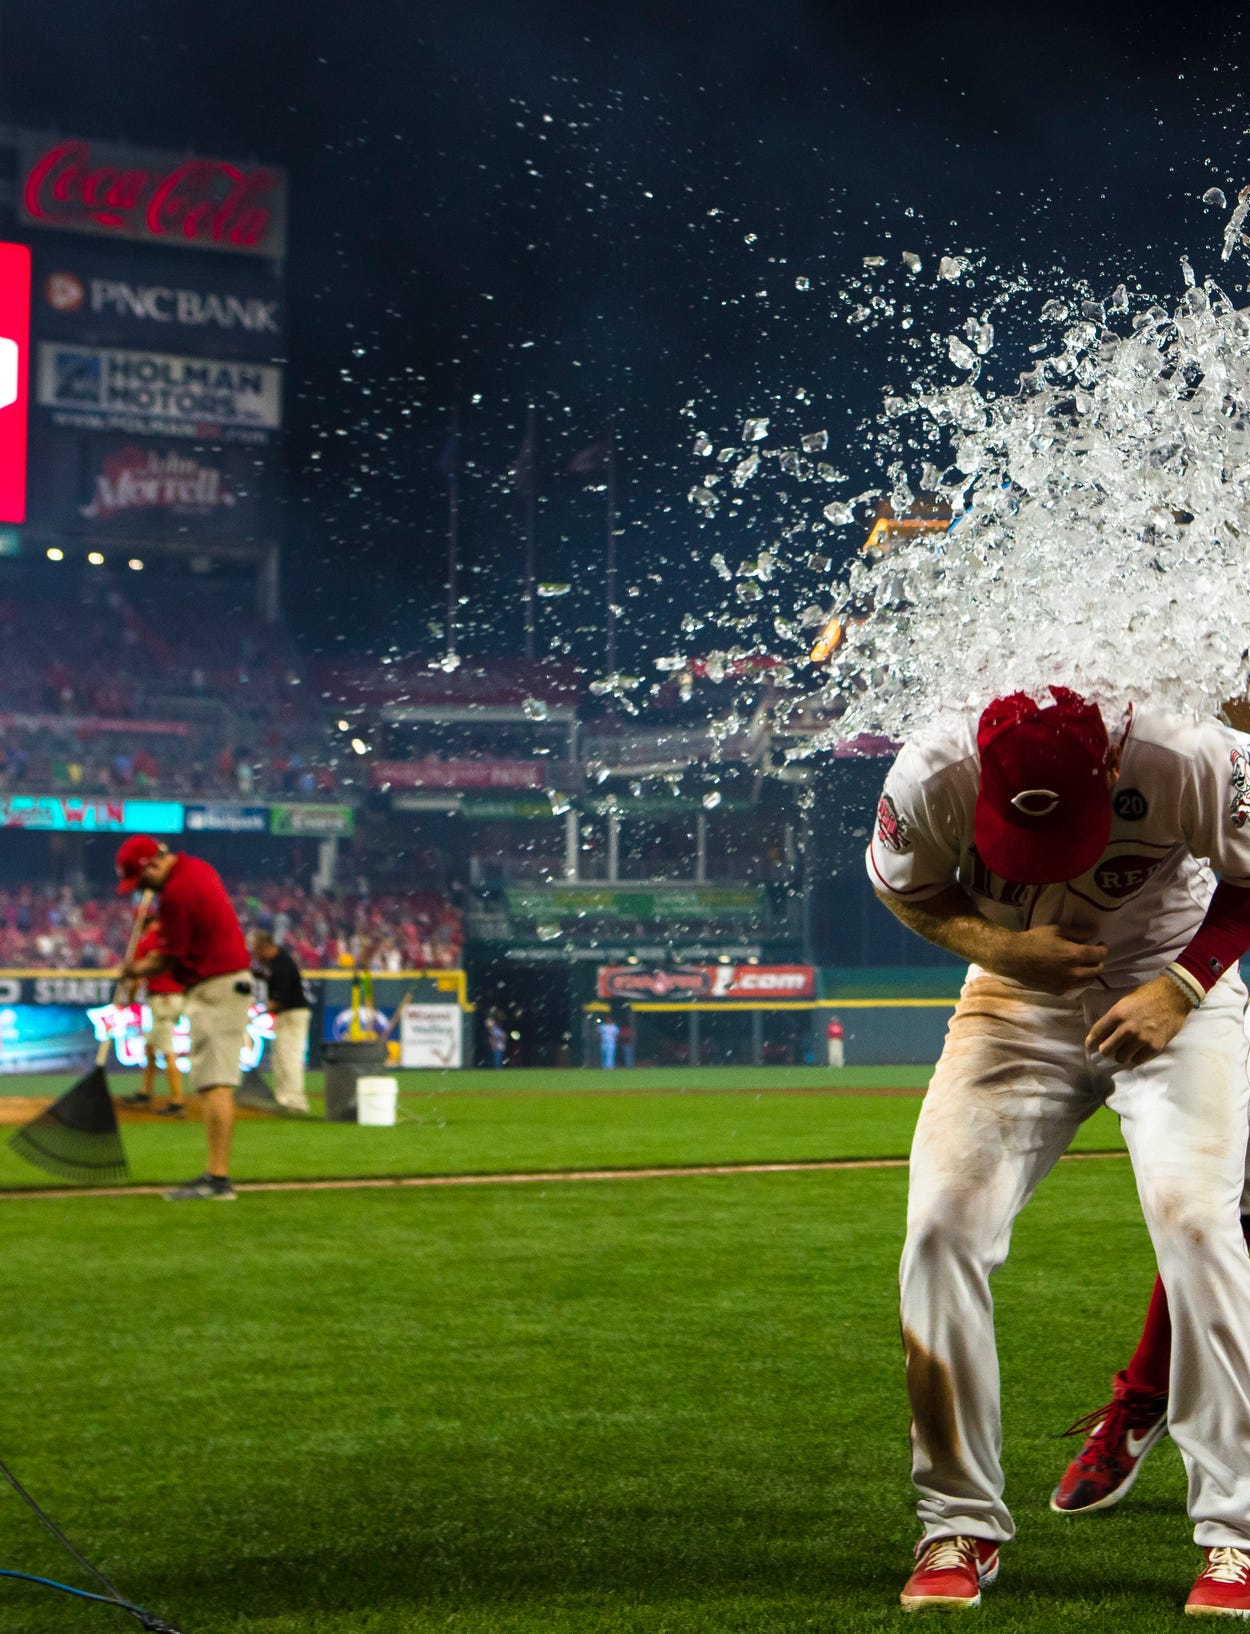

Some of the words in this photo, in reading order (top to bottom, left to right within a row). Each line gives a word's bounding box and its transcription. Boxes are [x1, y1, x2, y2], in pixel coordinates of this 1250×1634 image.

[108, 355, 263, 393] HOLMAN
[1119, 795, 1144, 815] 20
[33, 979, 110, 1003] START
